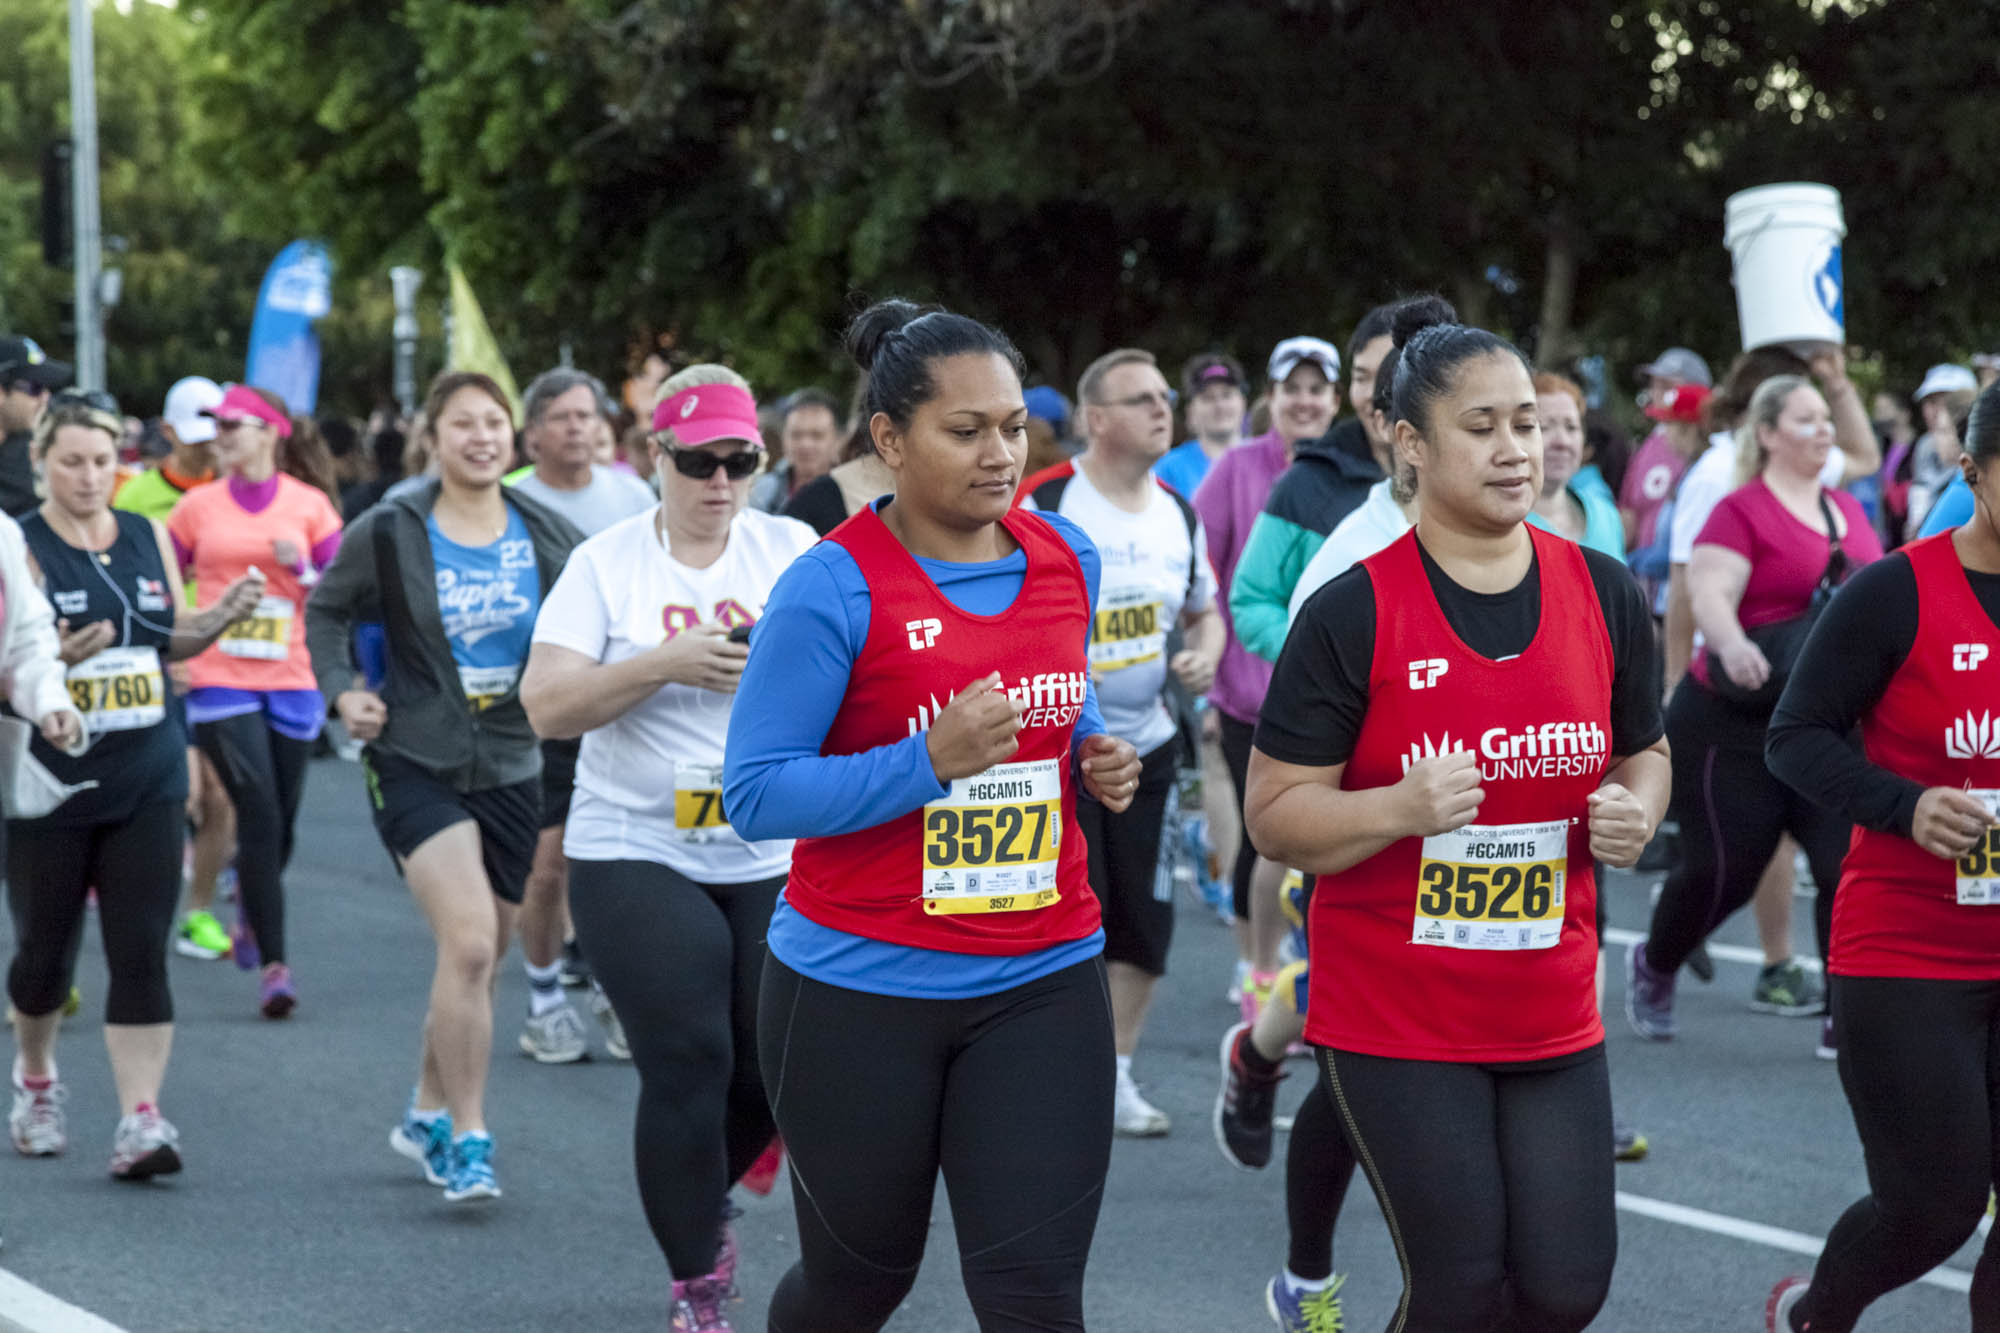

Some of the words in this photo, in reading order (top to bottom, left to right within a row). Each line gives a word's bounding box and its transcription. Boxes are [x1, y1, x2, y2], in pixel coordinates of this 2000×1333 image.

[501, 539, 535, 568] 23
[73, 674, 152, 712] 3760
[1019, 705, 1082, 729] VERSIT
[1480, 721, 1605, 760] Griffith
[1482, 753, 1605, 781] UNIVERSITY
[968, 780, 1033, 800] #GCAM15
[927, 804, 1048, 867] 3527
[1466, 841, 1536, 858] #GCAM15
[969, 878, 977, 888] D
[1420, 863, 1551, 919] 3526
[989, 897, 1015, 910] 3527
[1458, 930, 1466, 939] D
